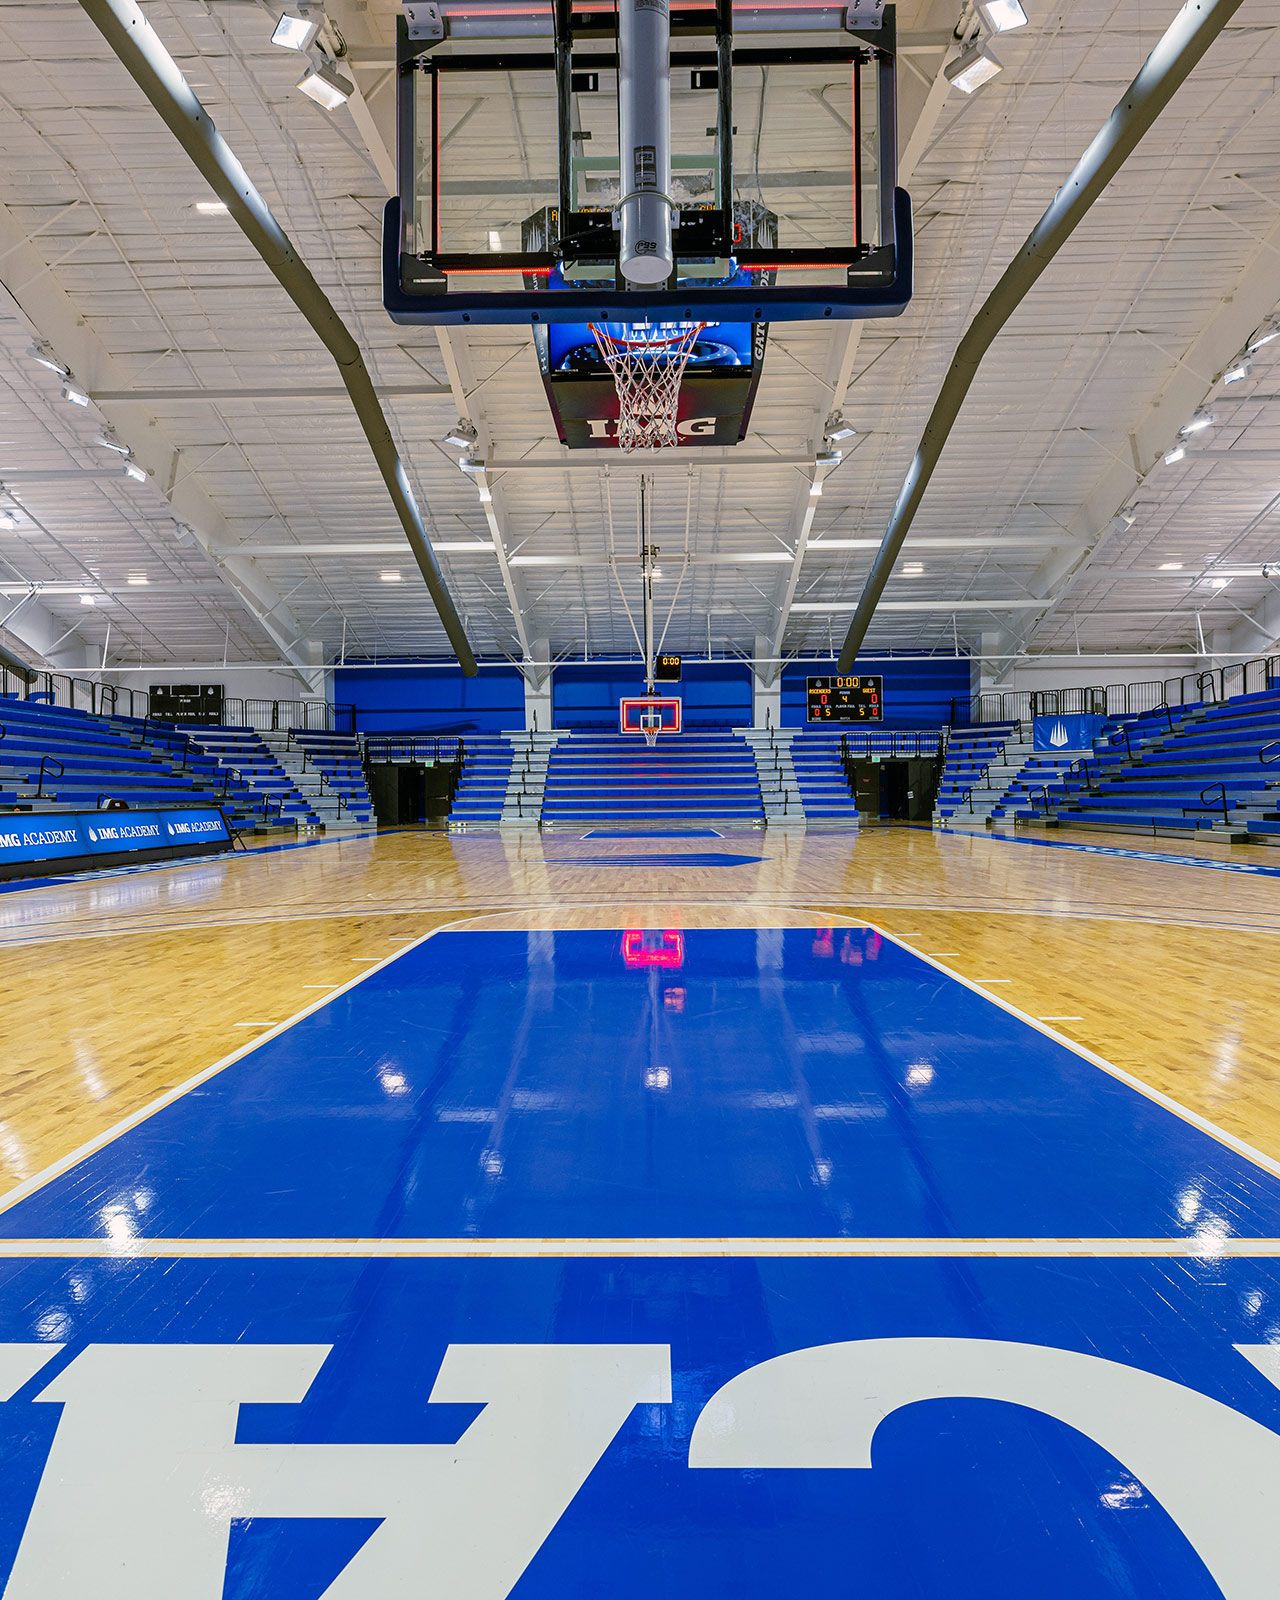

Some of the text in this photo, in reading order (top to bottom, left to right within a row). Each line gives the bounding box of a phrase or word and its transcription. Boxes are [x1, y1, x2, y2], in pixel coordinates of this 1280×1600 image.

[662, 657, 680, 666] 0:00
[836, 677, 859, 688] 0:00
[820, 694, 828, 705] 0
[842, 695, 848, 703] 4
[871, 693, 878, 704] 0
[814, 708, 820, 717] 0
[825, 708, 831, 717] 5
[859, 707, 865, 716] 5
[872, 707, 878, 716] 0
[97, 824, 160, 840] IMG ACADEMY
[174, 820, 223, 834] IMG ACADEMY
[23, 829, 78, 846] ACADEMY
